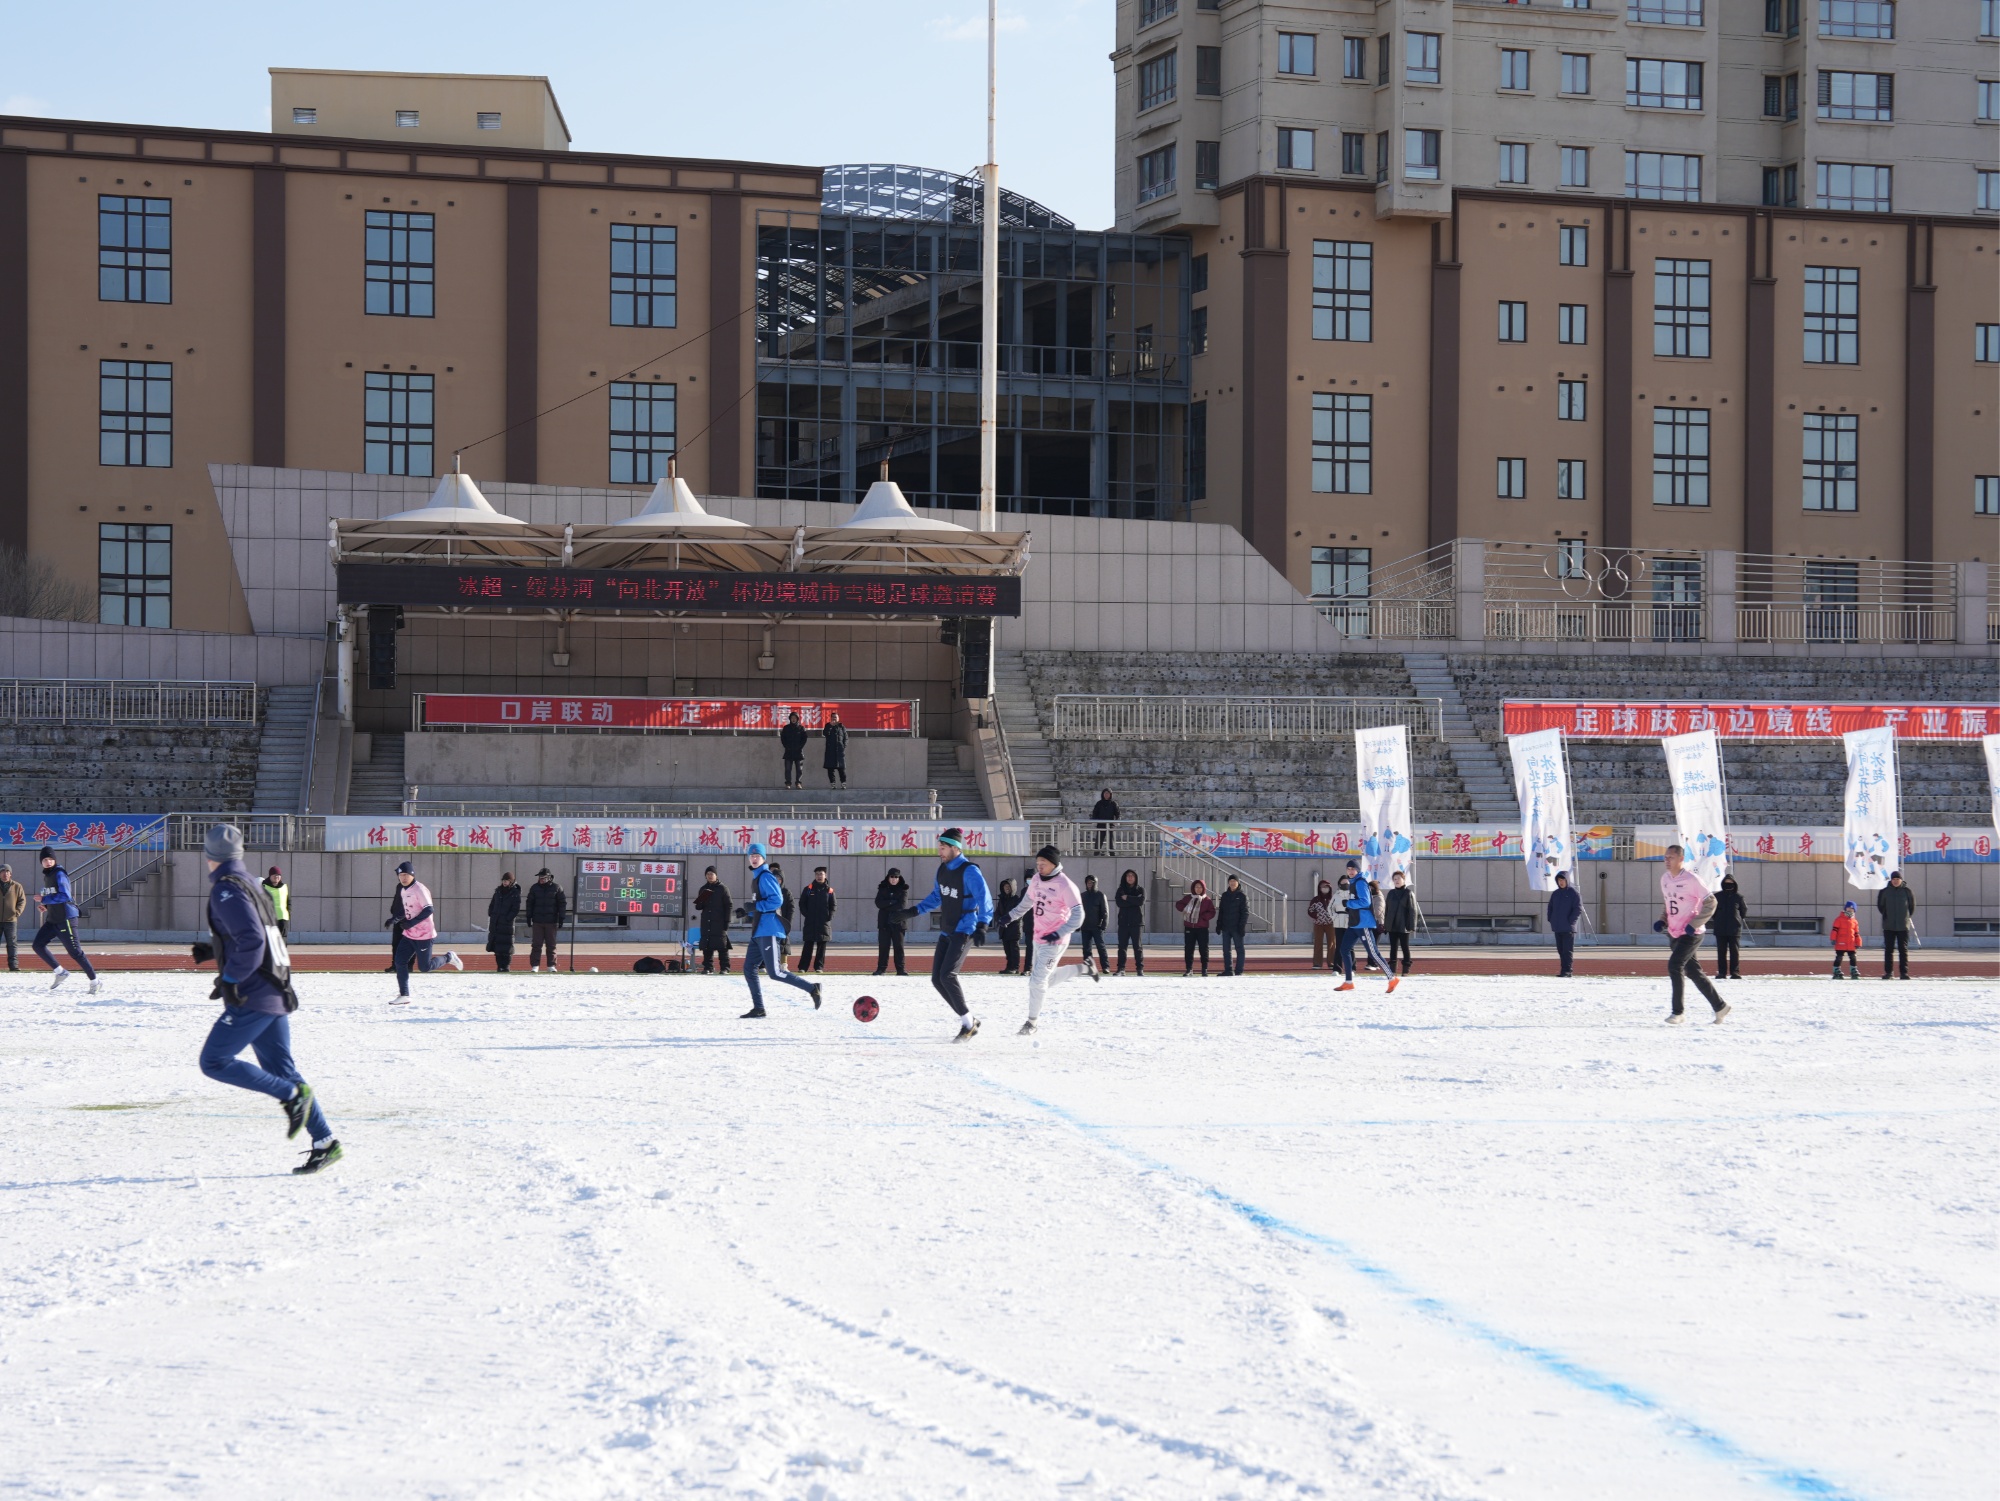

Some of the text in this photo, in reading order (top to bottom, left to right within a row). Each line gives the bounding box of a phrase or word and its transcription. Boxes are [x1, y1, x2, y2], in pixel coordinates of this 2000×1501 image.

[501, 700, 613, 723] 口岸联动
[1574, 707, 1832, 733] 足球跃动边境线
[0, 821, 135, 847] 生命更精彩
[698, 825, 988, 851] 城市因体育勃发机
[1209, 829, 1285, 855] 少年强
[1303, 829, 1364, 855] 中国
[1410, 830, 1473, 855] 育强
[585, 861, 617, 872] 绥芬河
[627, 863, 636, 873] VS
[643, 863, 676, 874] 海参崴
[601, 876, 611, 891] 0
[666, 878, 675, 893] 0
